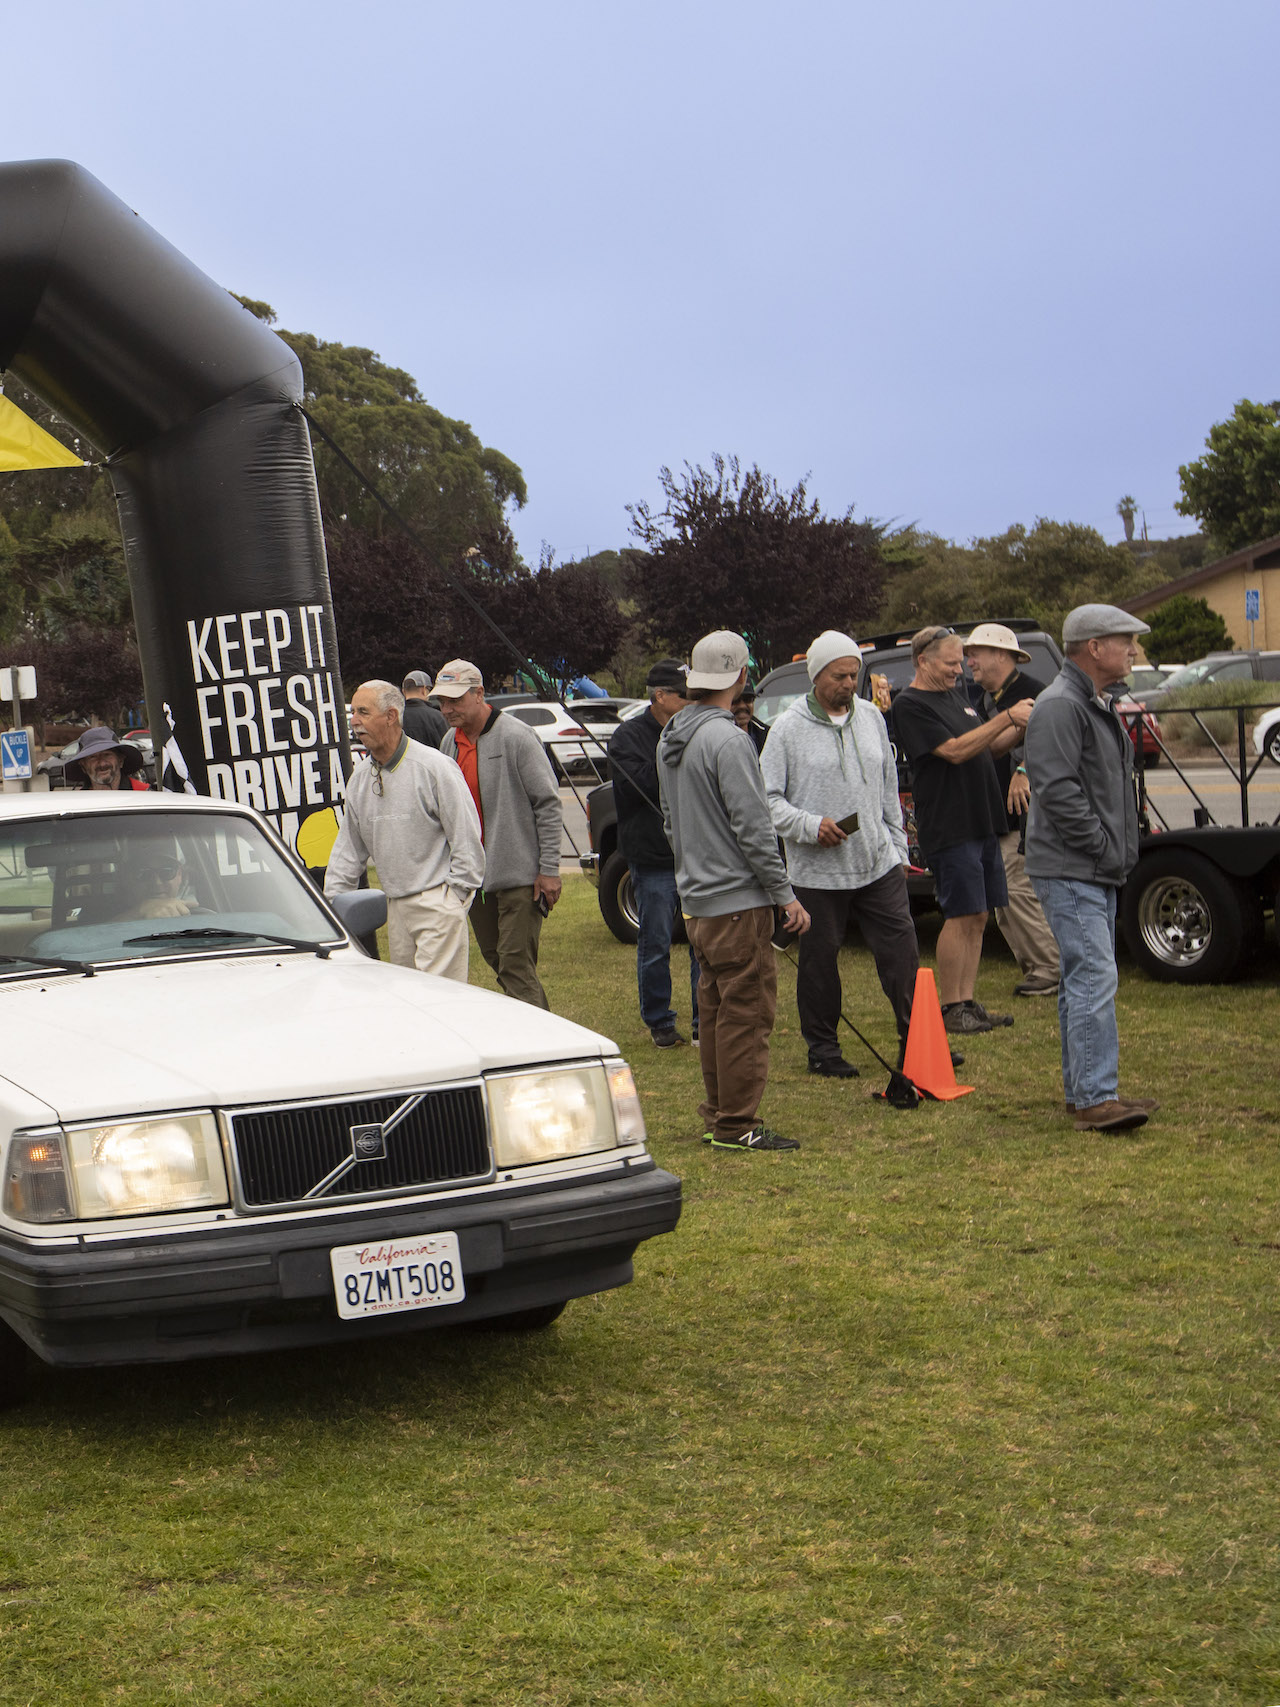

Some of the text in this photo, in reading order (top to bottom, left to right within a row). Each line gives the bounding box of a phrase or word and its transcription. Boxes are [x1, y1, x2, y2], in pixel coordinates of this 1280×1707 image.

[187, 605, 326, 683] KEEP IT
[196, 671, 341, 760] FRESH
[206, 748, 347, 812] DRIVE A
[359, 1242, 437, 1266] California
[344, 1260, 455, 1306] 8ZMT508
[371, 1296, 435, 1311] dmv.ca.gov
